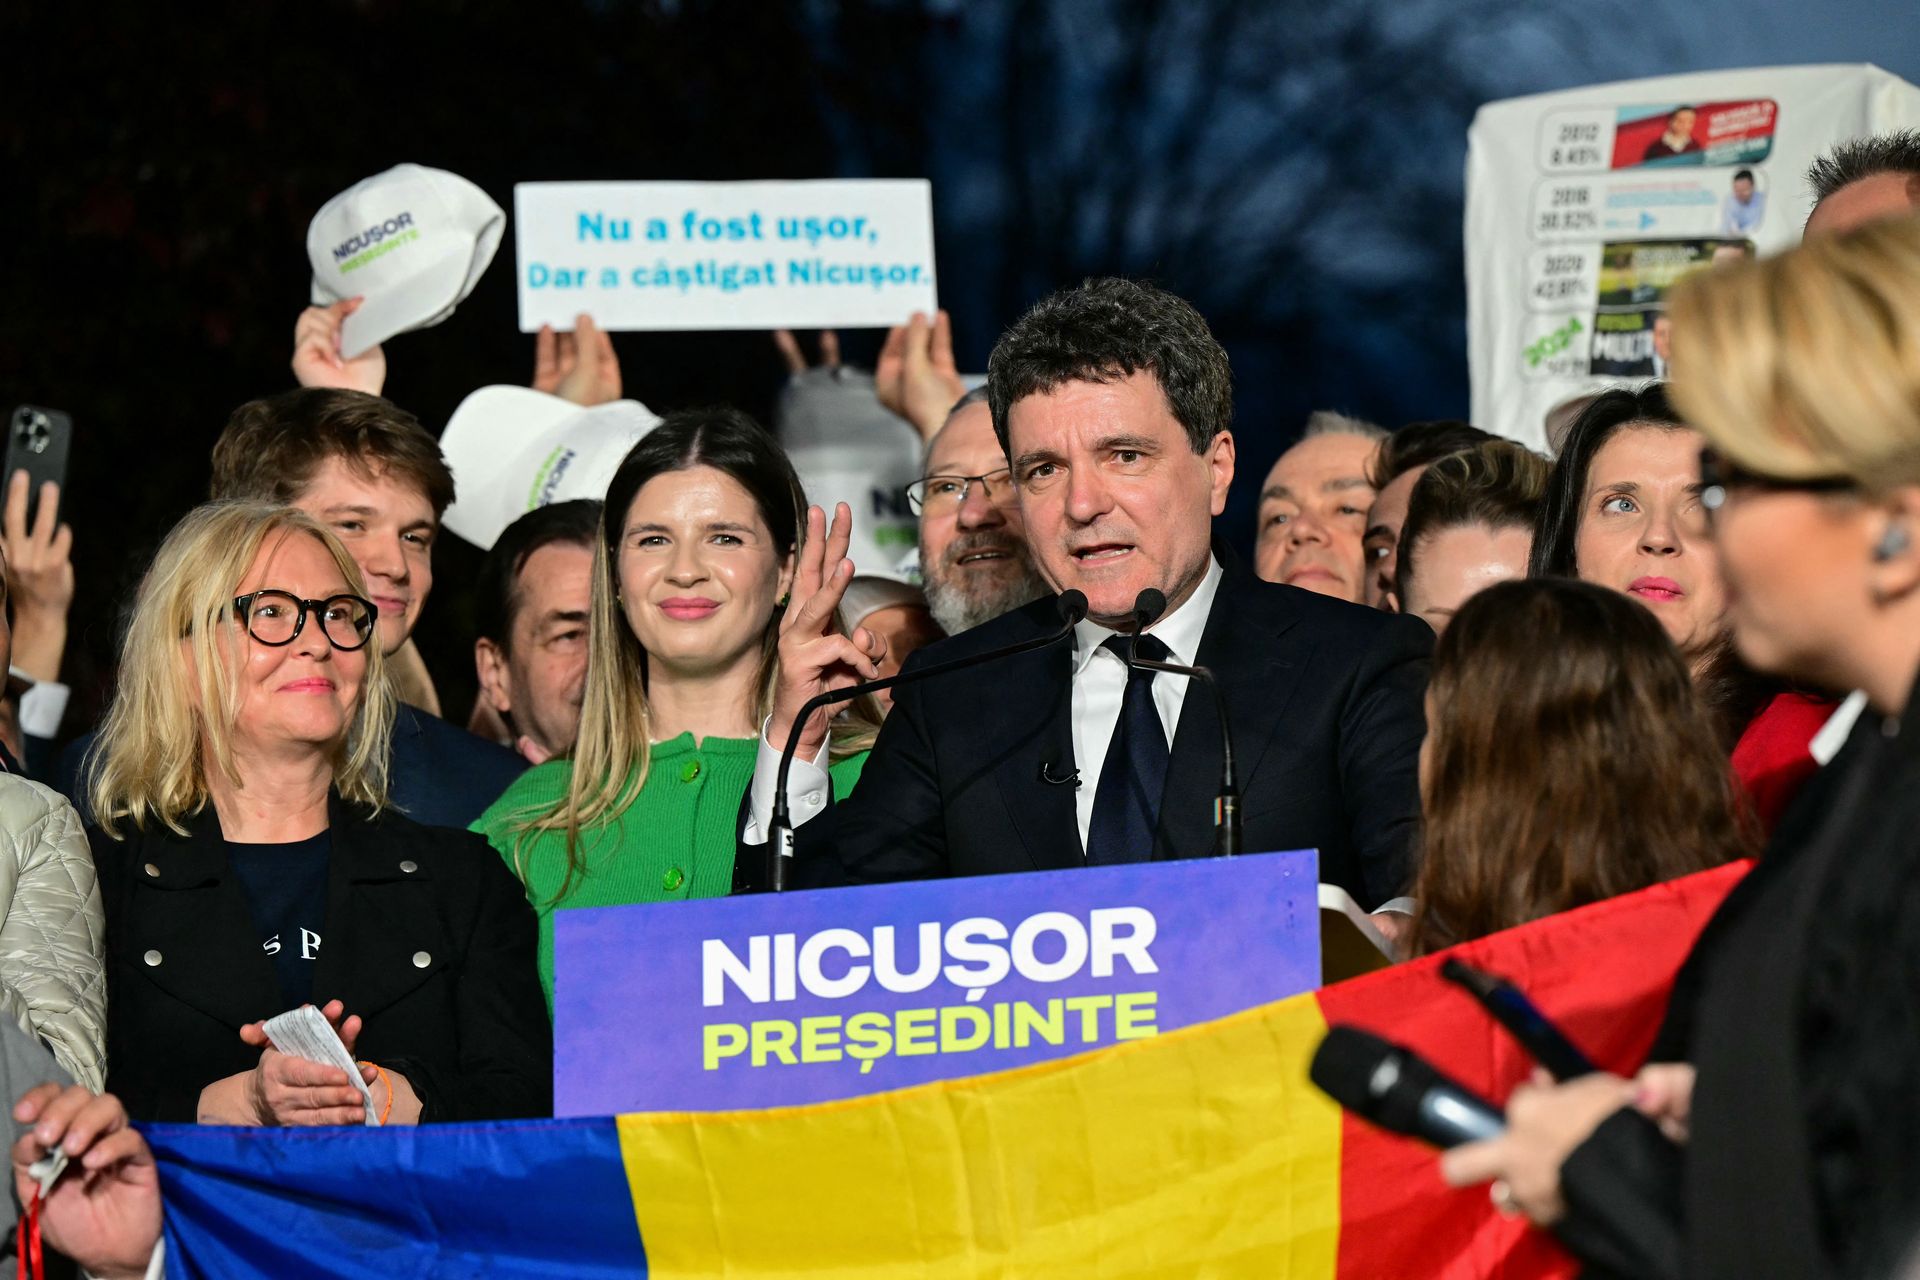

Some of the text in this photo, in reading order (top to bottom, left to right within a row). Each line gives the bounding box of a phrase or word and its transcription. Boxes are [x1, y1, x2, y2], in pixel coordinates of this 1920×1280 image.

[576, 208, 879, 248] Nu a fost ușor,
[527, 261, 589, 290] Dar
[599, 266, 621, 290] a
[703, 906, 1159, 1003] NICUȘOR
[703, 991, 1158, 1074] PREȘEDINTE
